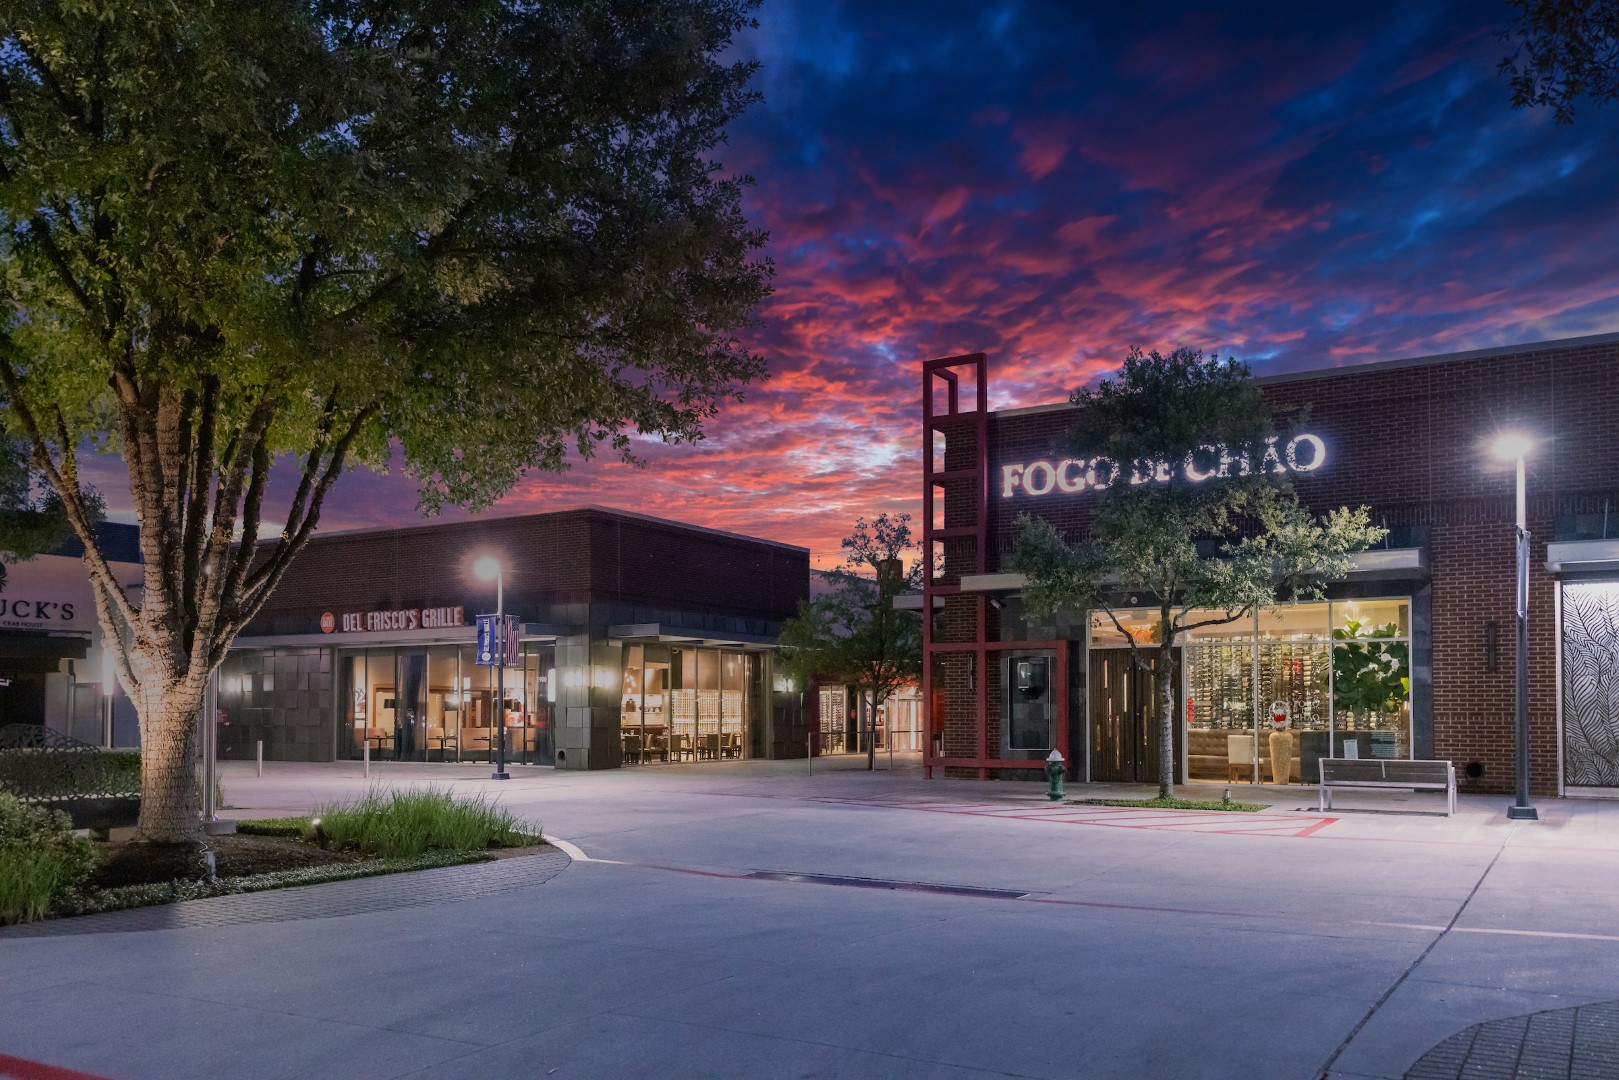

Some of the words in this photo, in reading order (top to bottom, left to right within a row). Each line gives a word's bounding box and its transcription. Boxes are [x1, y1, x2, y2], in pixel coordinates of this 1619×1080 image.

[1002, 456, 1120, 497] FOGO
[342, 612, 364, 632] DEL
[367, 609, 419, 632] FRISCO'S
[422, 606, 464, 628] GRILLE
